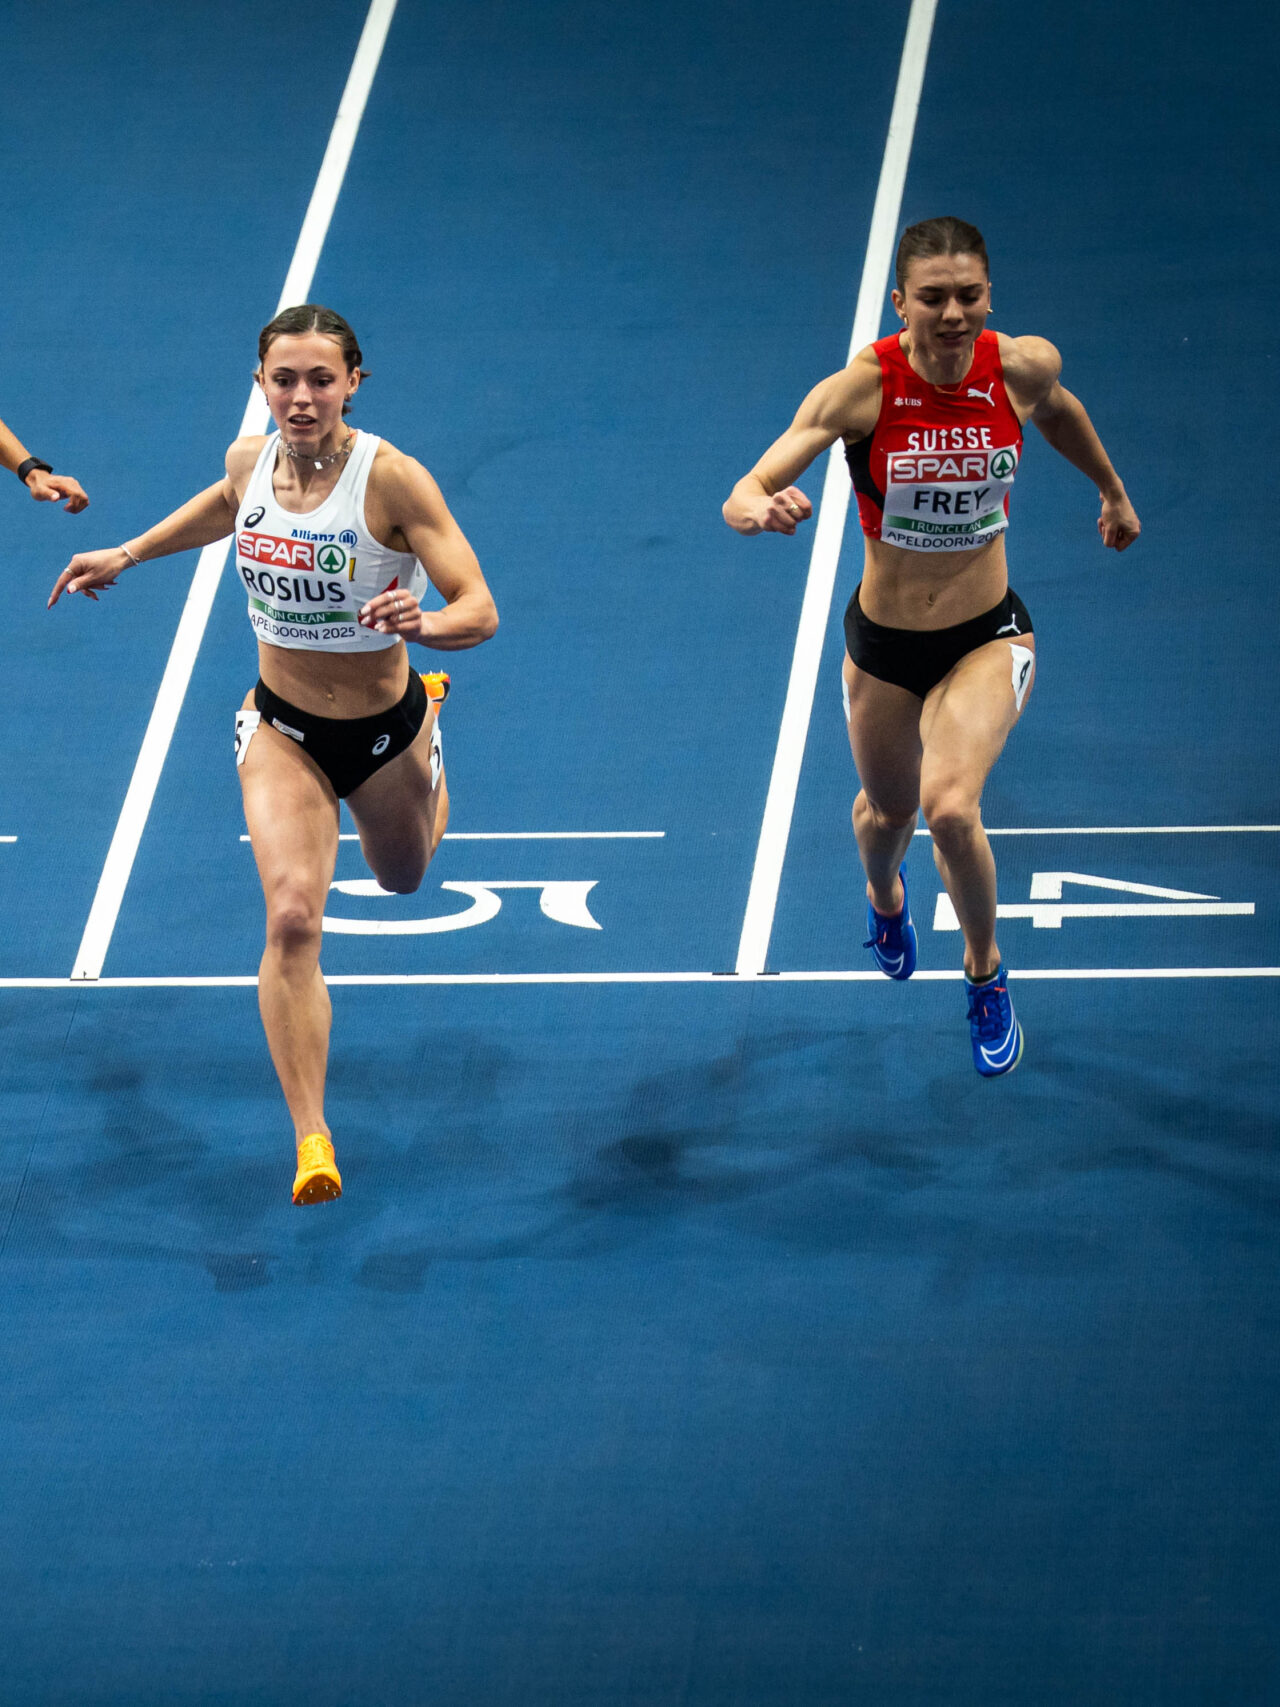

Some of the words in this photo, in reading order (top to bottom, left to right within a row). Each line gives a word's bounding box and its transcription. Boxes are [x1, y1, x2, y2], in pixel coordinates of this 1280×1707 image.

[904, 397, 922, 406] UBS
[893, 456, 985, 480] SPAR
[913, 487, 992, 515] FREY
[291, 529, 335, 542] Allianz
[887, 530, 974, 548] APELDOORN
[916, 521, 944, 533] RUN
[238, 534, 313, 567] SPAR
[241, 566, 346, 603] ROSIUS
[267, 605, 285, 621] RUN
[250, 614, 319, 640] APELDOORN
[322, 627, 356, 640] 2025
[322, 878, 603, 935] 5
[932, 871, 1255, 931] 4
